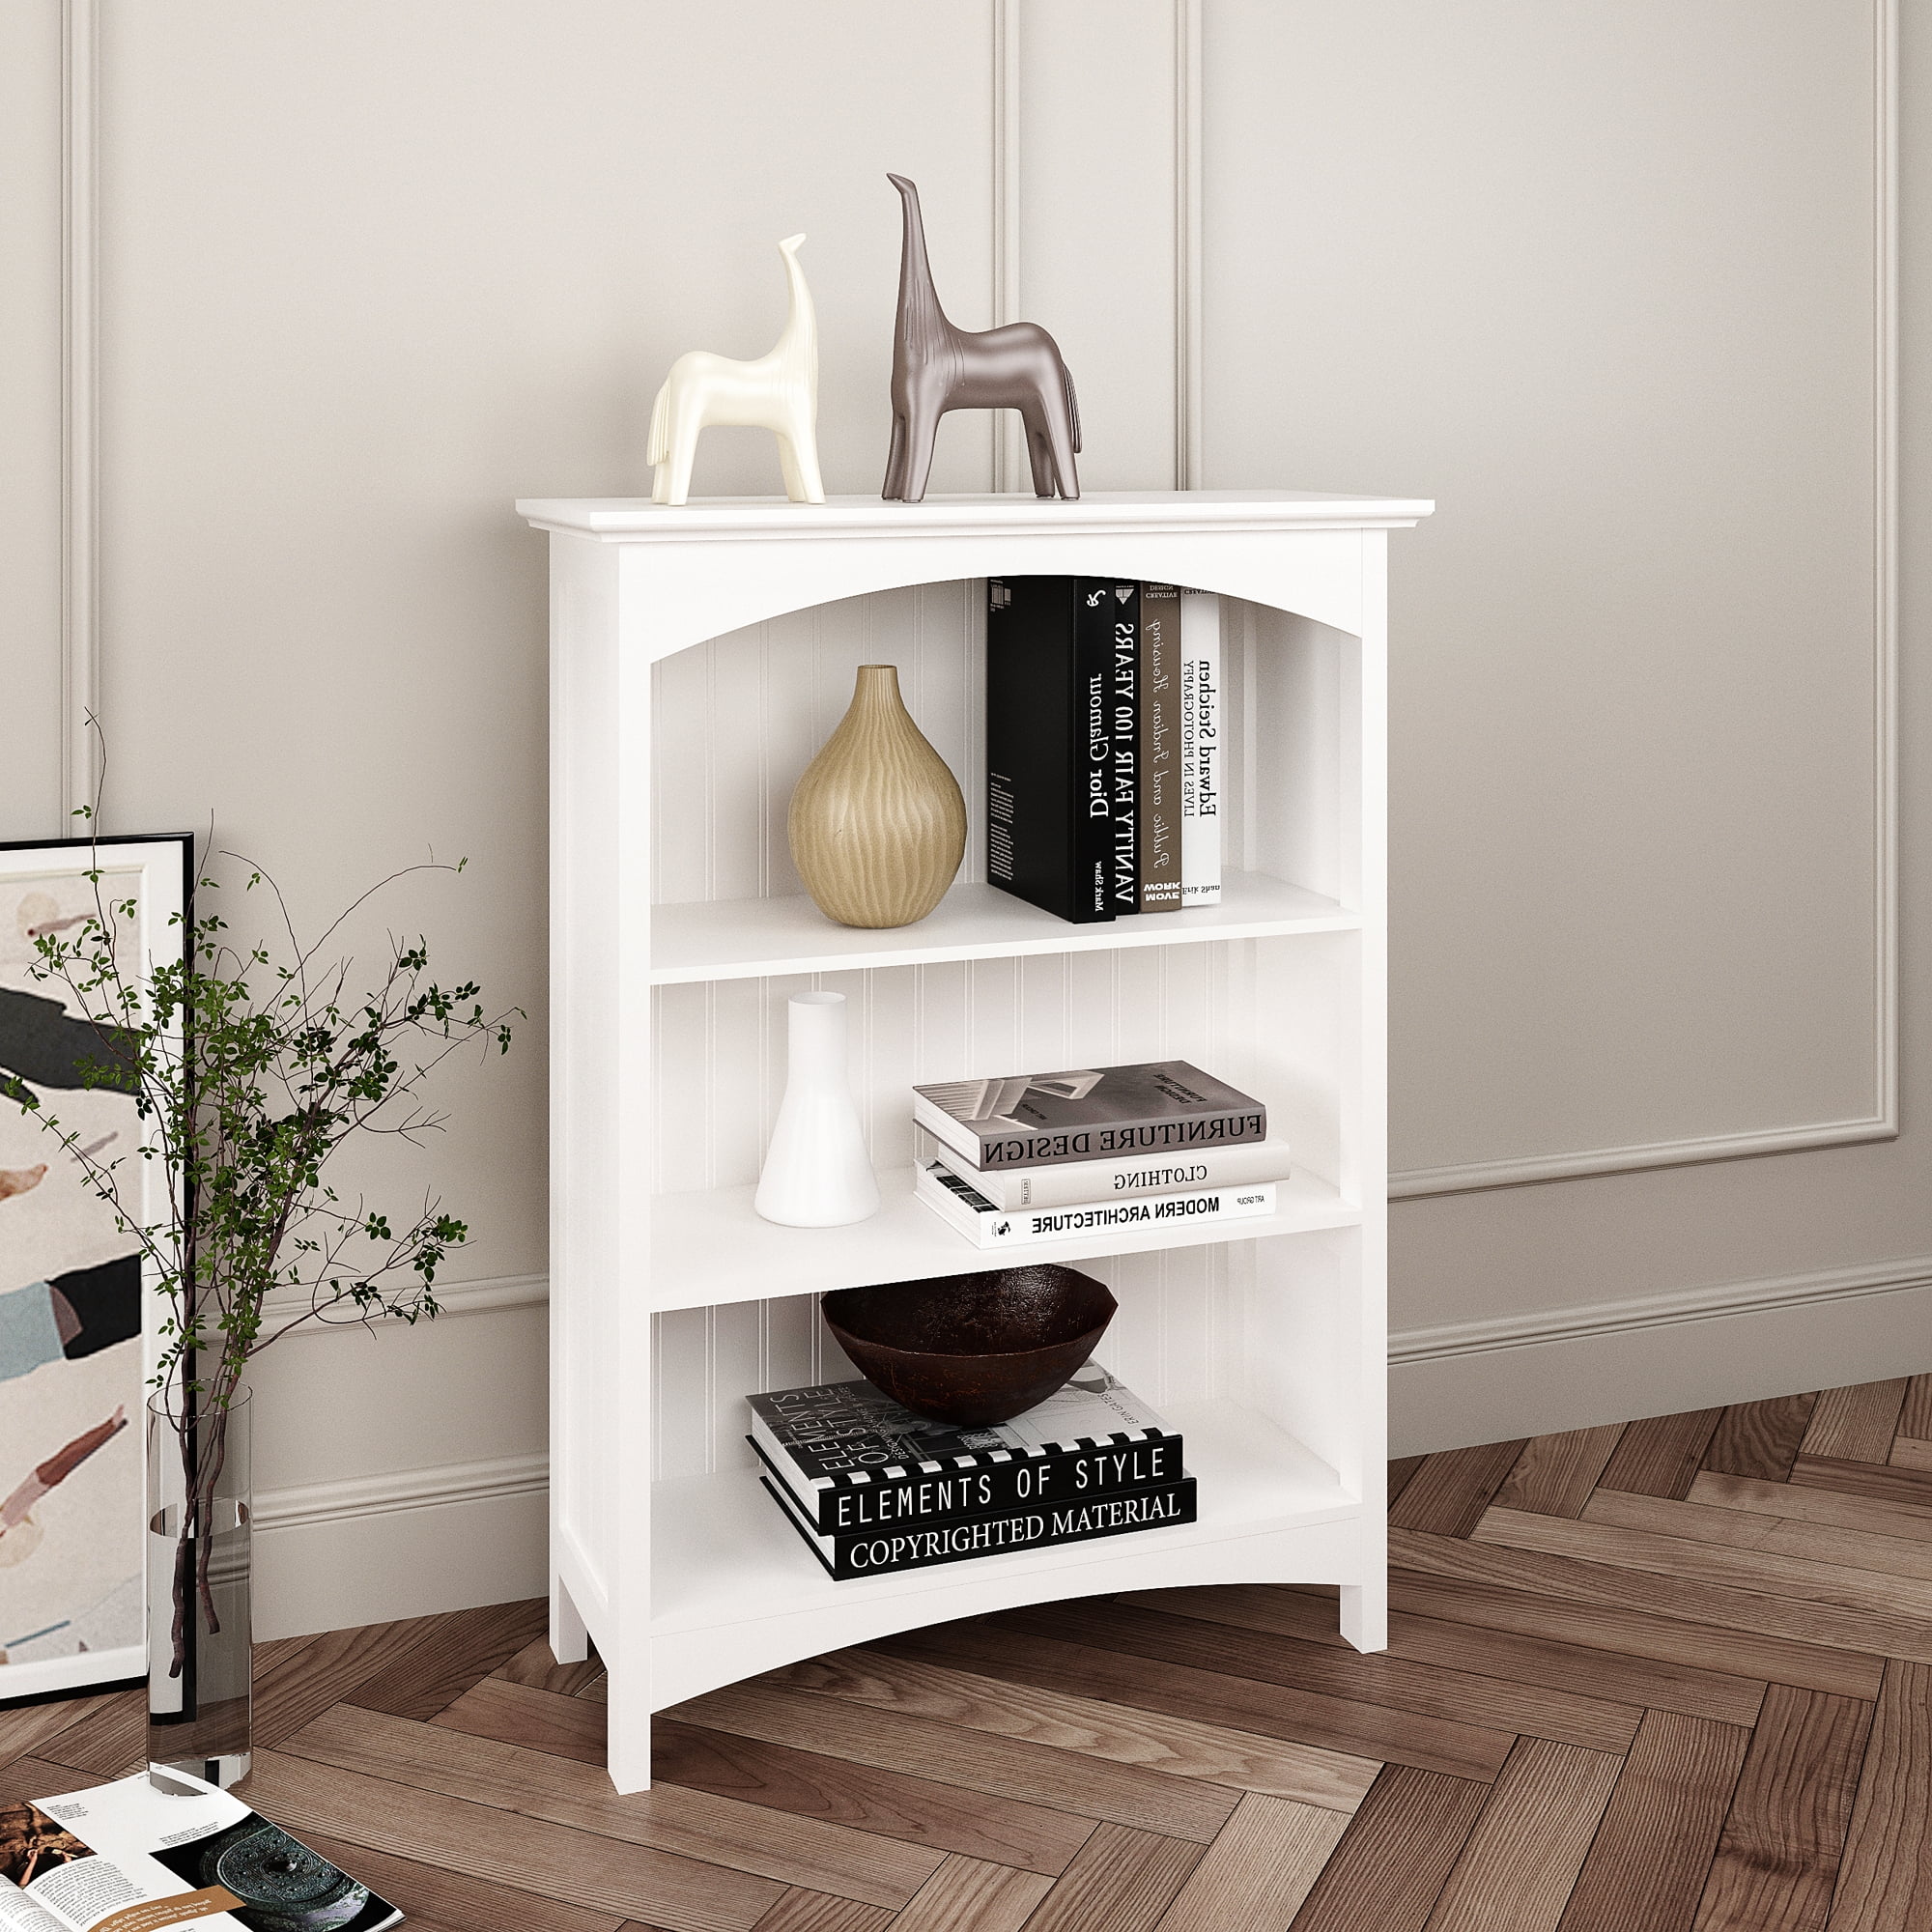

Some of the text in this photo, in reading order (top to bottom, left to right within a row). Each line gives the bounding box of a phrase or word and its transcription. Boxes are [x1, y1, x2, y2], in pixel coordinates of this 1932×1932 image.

[770, 1394, 855, 1471] ELEMENTS
[804, 1389, 889, 1464] OF STYLE
[1095, 1393, 1140, 1424] ERIN GATES
[838, 1447, 1165, 1526] ELEMENTS OF STYLE
[850, 1492, 1181, 1569] COPYRIGHTED MATERIAL
